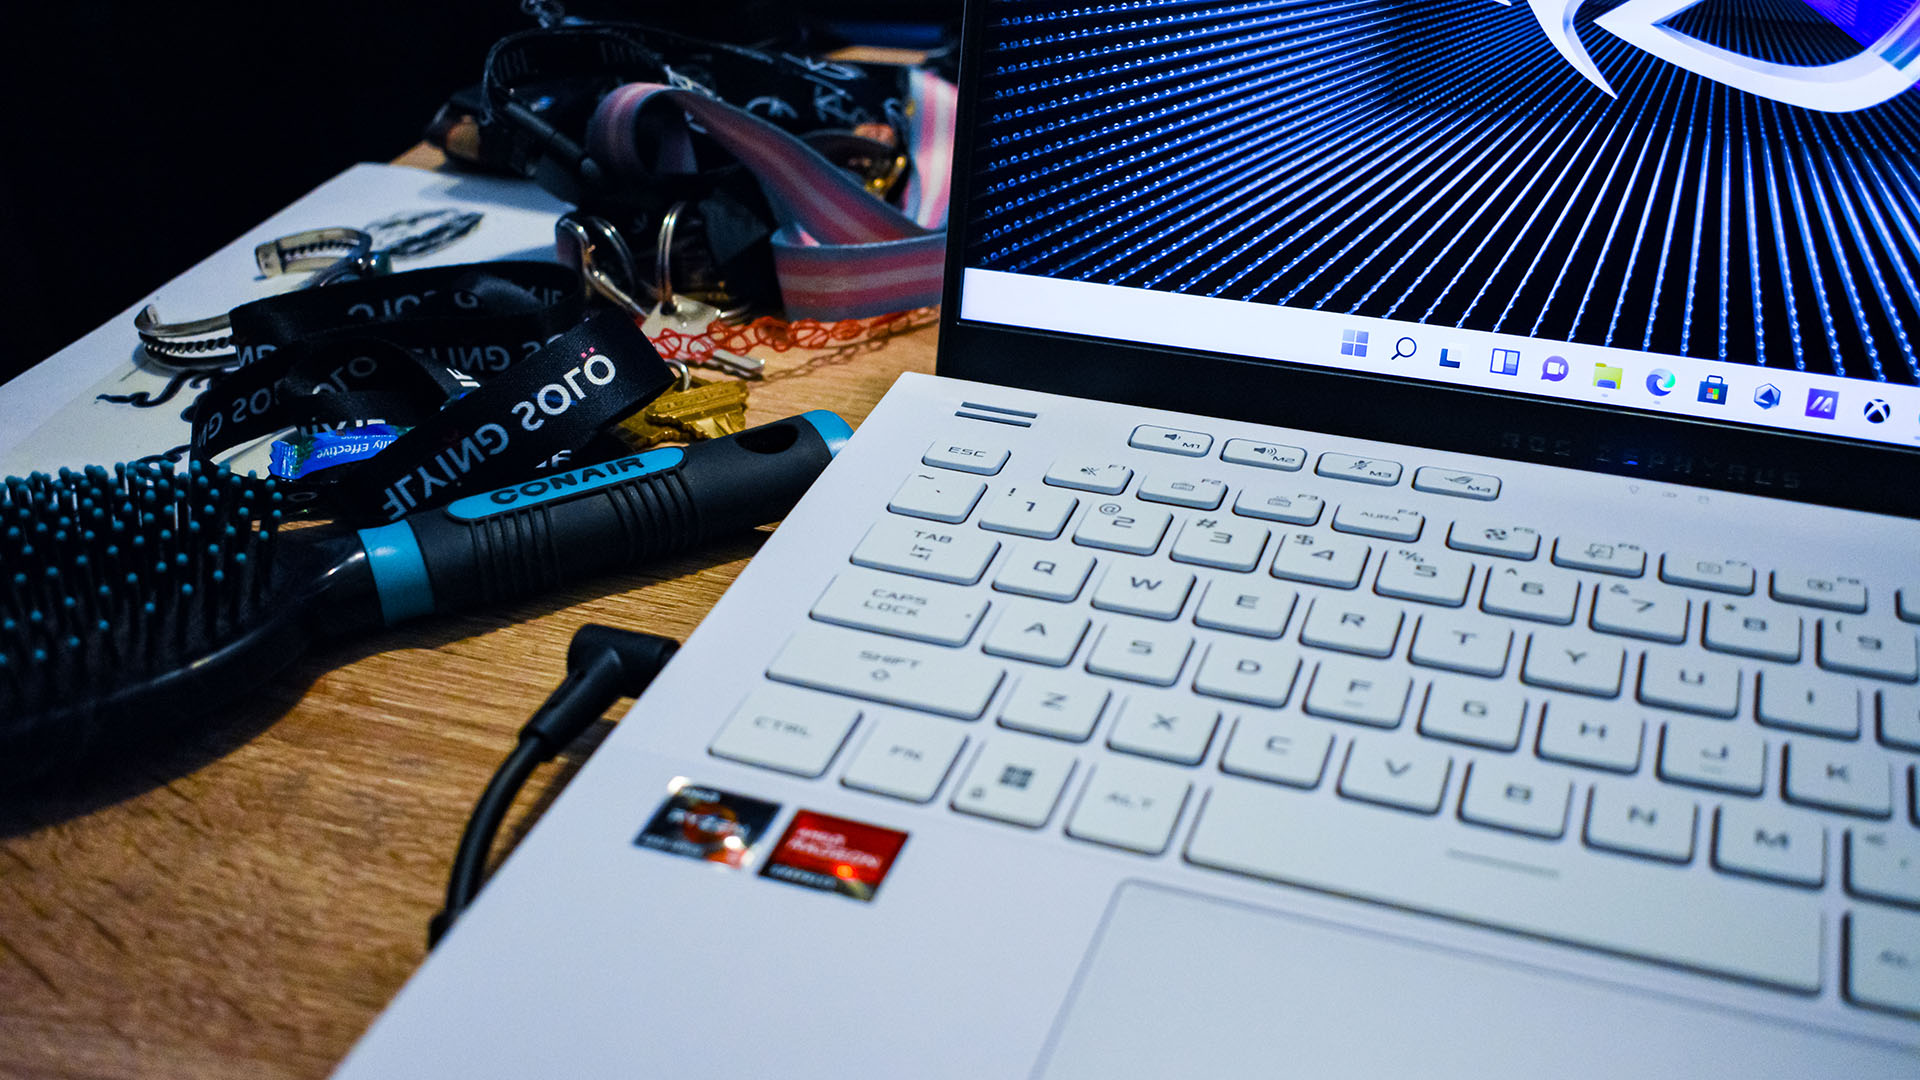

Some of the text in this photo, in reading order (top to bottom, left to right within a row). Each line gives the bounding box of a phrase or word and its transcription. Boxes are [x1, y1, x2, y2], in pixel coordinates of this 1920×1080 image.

[316, 443, 369, 459] Effective
[948, 446, 987, 458] ESC
[489, 458, 645, 505] CONAIR
[1369, 471, 1392, 479] M3
[1466, 484, 1492, 493] M4
[1026, 502, 1036, 512] 1
[1098, 503, 1122, 516] @
[1111, 516, 1136, 528] 2
[1196, 518, 1218, 529] #
[915, 530, 953, 543] TAB
[1211, 533, 1232, 544] 3
[1312, 550, 1334, 560] 4
[1398, 550, 1424, 562] %
[1033, 561, 1056, 575] Q
[1416, 565, 1437, 577] 5
[1131, 577, 1162, 590] W
[1521, 583, 1543, 595] 6
[872, 588, 928, 607] CAPS
[1235, 595, 1260, 609] E
[863, 600, 921, 617] LOCK
[1631, 599, 1656, 612] 7
[1341, 614, 1365, 626] R
[1025, 623, 1046, 635] A
[1452, 630, 1478, 645] T
[1130, 640, 1152, 655] S
[860, 650, 921, 669] SHIFT
[1565, 650, 1588, 663] Y
[1237, 660, 1261, 673] D
[1680, 670, 1705, 685] U
[1347, 679, 1372, 693] F
[1041, 693, 1067, 710] Z
[1463, 701, 1487, 716] G
[753, 716, 811, 737] CTRL
[1153, 714, 1177, 731] X
[1580, 723, 1606, 738] H
[1266, 736, 1292, 754] C
[889, 746, 922, 761] FN
[1703, 746, 1729, 759] J
[1385, 760, 1410, 777] V
[1826, 764, 1850, 781] K
[1505, 785, 1532, 801] B
[1628, 807, 1657, 825] N
[1755, 830, 1790, 849] M
